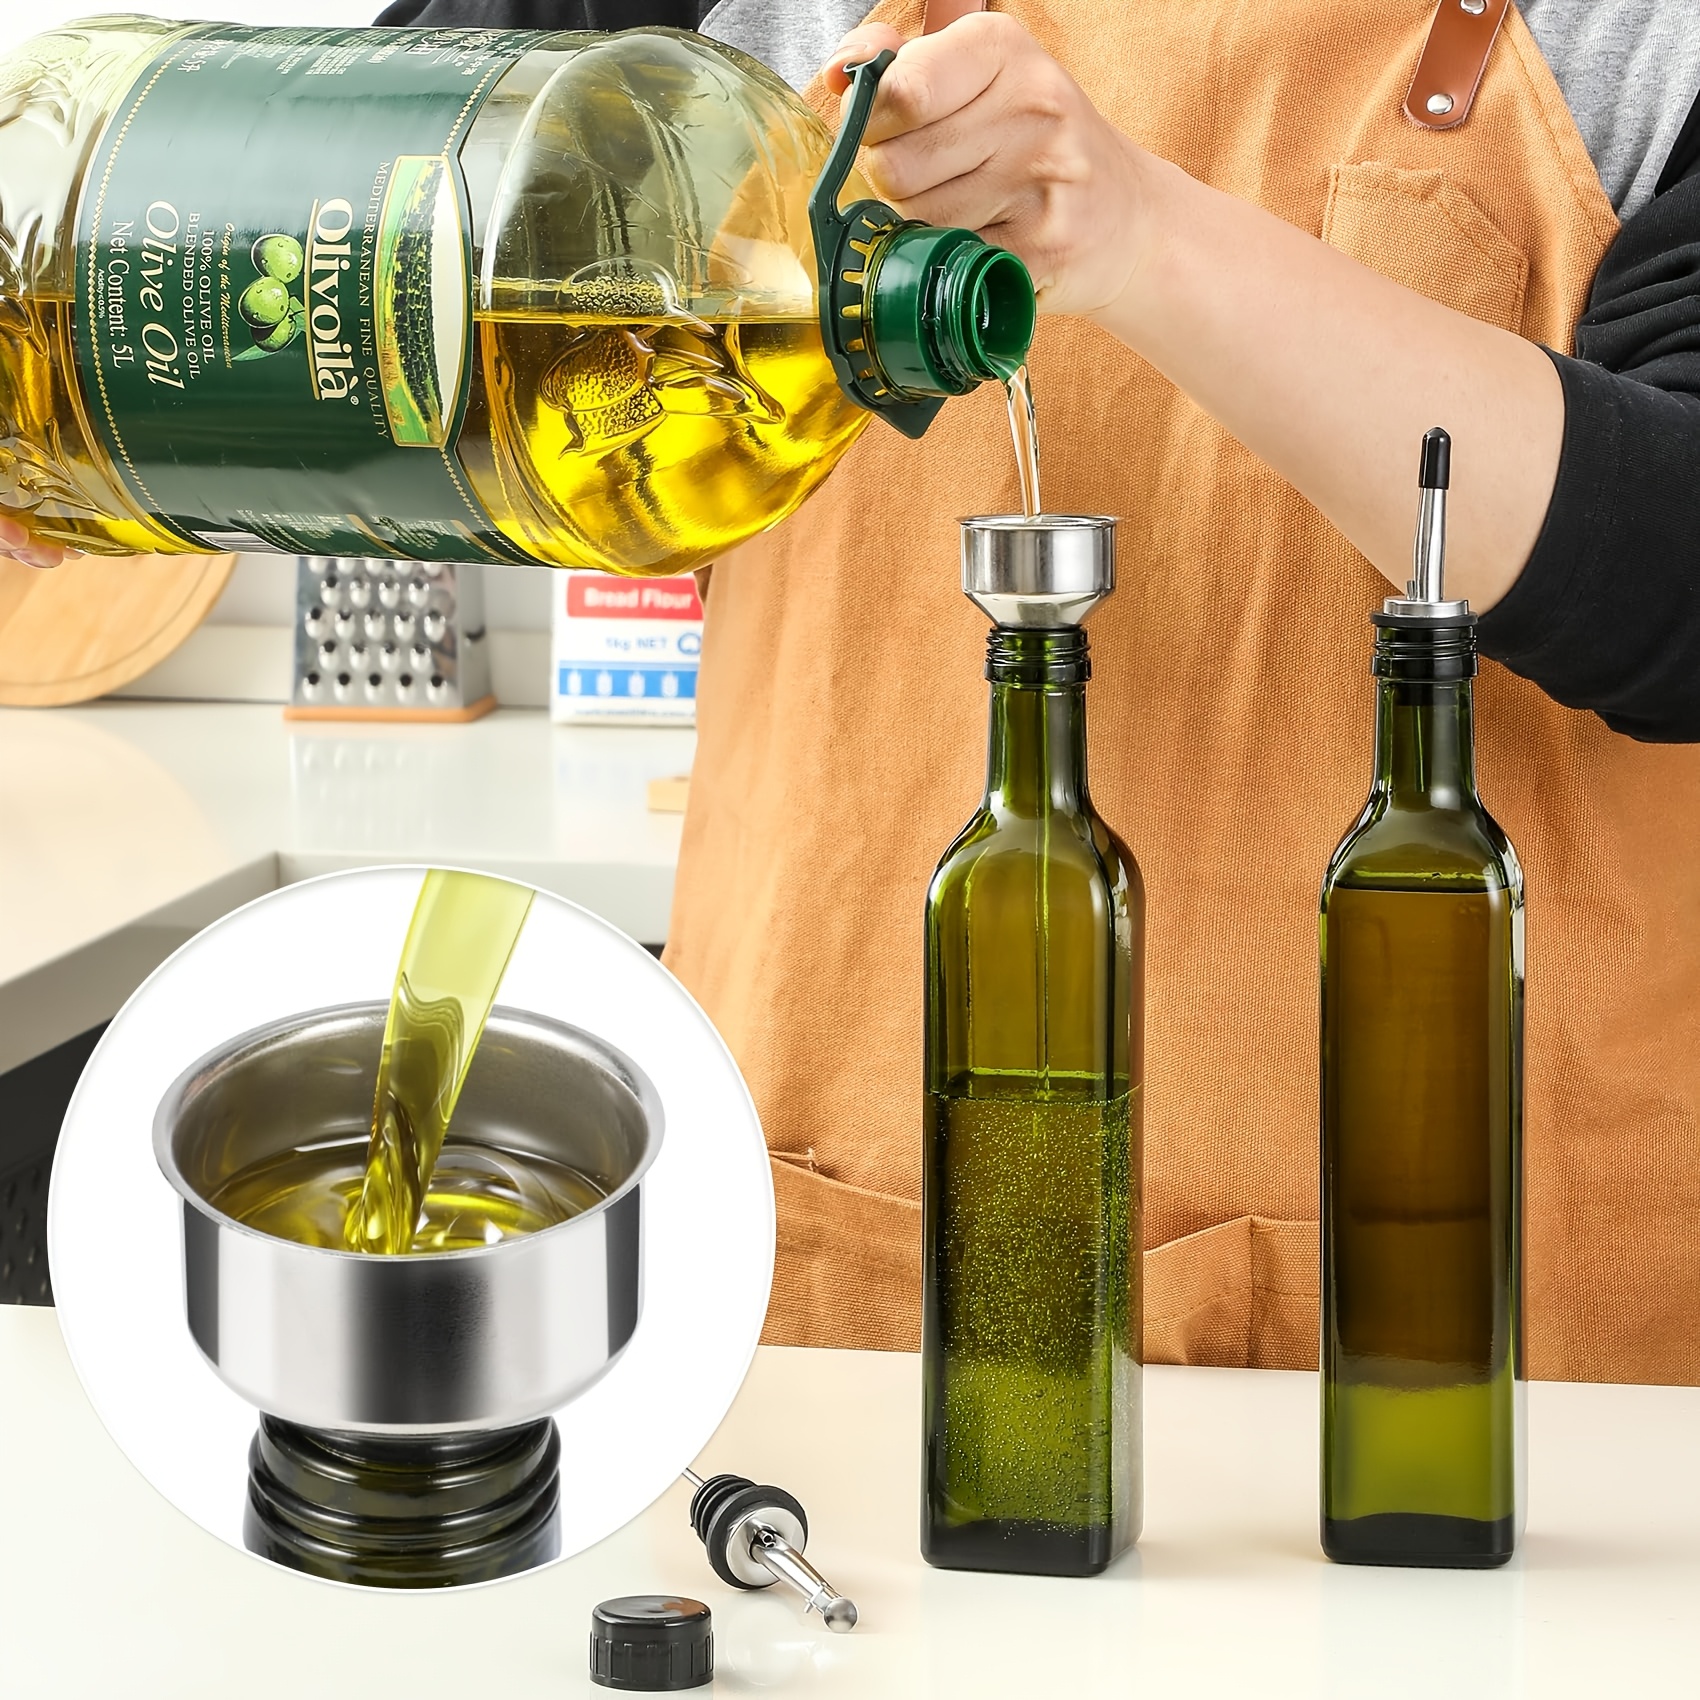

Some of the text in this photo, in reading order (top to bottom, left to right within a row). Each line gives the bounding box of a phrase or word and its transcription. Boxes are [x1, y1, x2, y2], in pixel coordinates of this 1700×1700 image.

[107, 220, 135, 369] Net Content: 5L
[139, 200, 185, 390] Olive Oil
[182, 212, 200, 379] BLENDED OLIVE OIL
[199, 230, 215, 364] 100% OLIVE OIL
[218, 222, 235, 369] Origin of the Mediterranean
[359, 161, 390, 439] MEDITERRANEAN FINE QUALITY
[583, 586, 694, 609] Bread Flour
